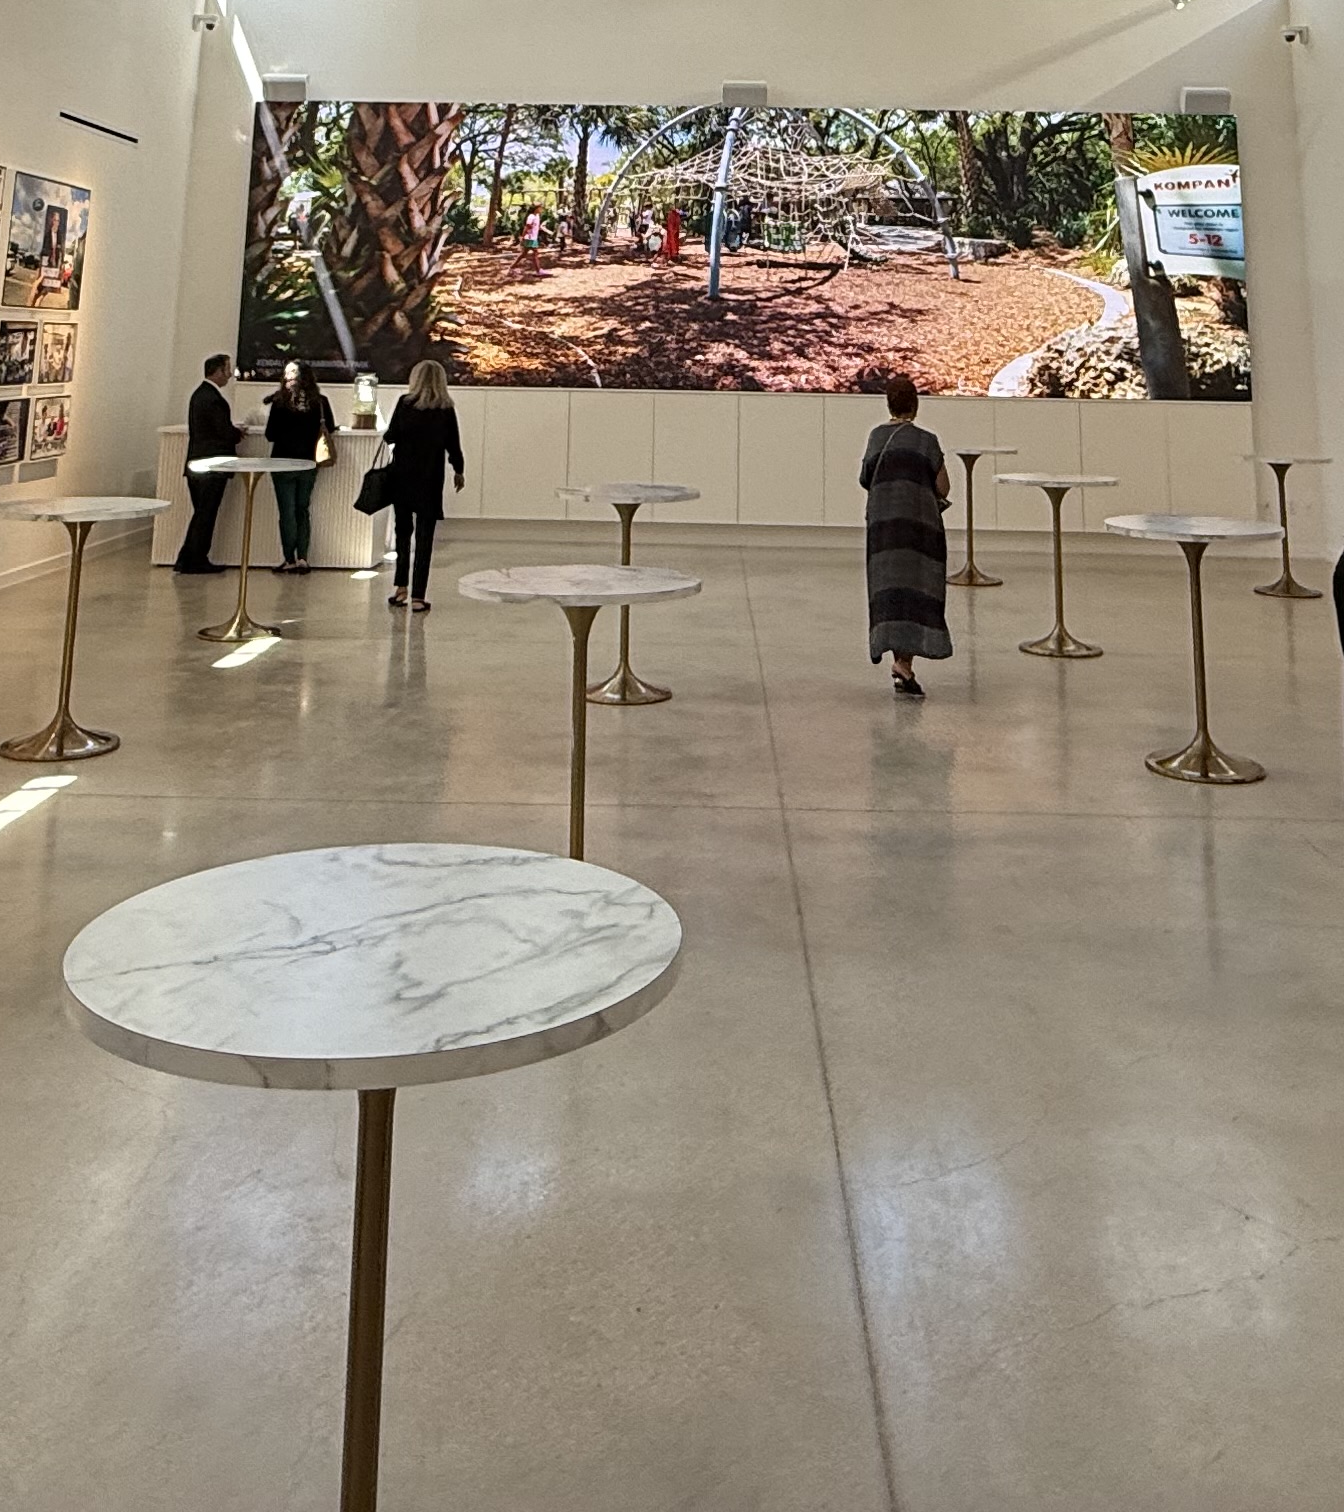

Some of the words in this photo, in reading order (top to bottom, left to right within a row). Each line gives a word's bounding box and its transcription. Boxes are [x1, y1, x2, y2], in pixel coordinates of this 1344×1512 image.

[1153, 178, 1231, 191] KOMPAN
[1167, 208, 1240, 218] WELCOME
[1188, 233, 1224, 247] 5-12
